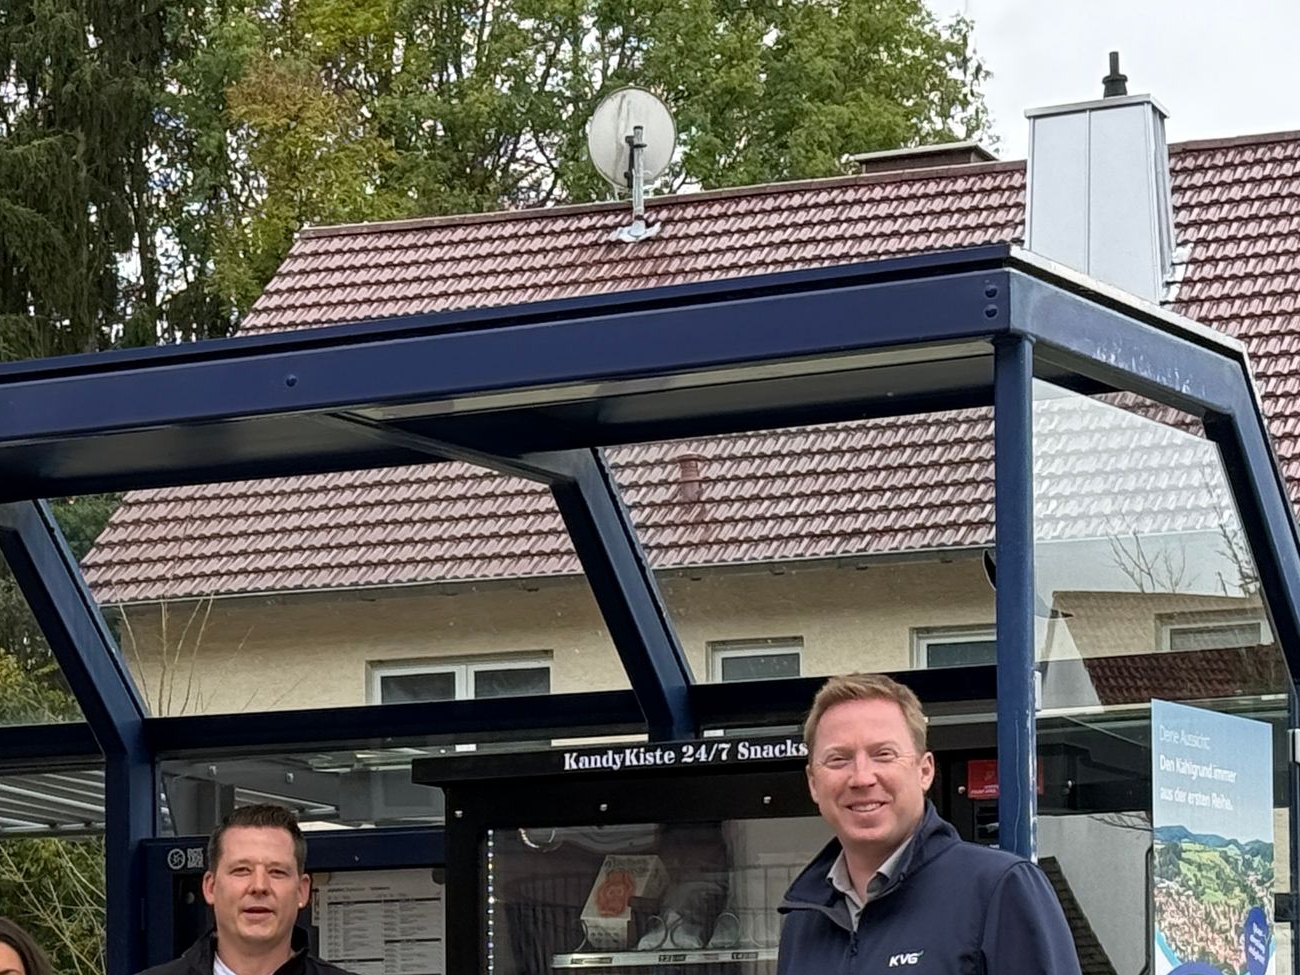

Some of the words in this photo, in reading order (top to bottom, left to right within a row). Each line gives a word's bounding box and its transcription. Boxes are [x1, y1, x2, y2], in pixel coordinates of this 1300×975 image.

[563, 747, 676, 771] KandyKiste
[681, 743, 732, 764] 24/7
[737, 739, 809, 760] Snacks
[889, 950, 924, 967] KVG
